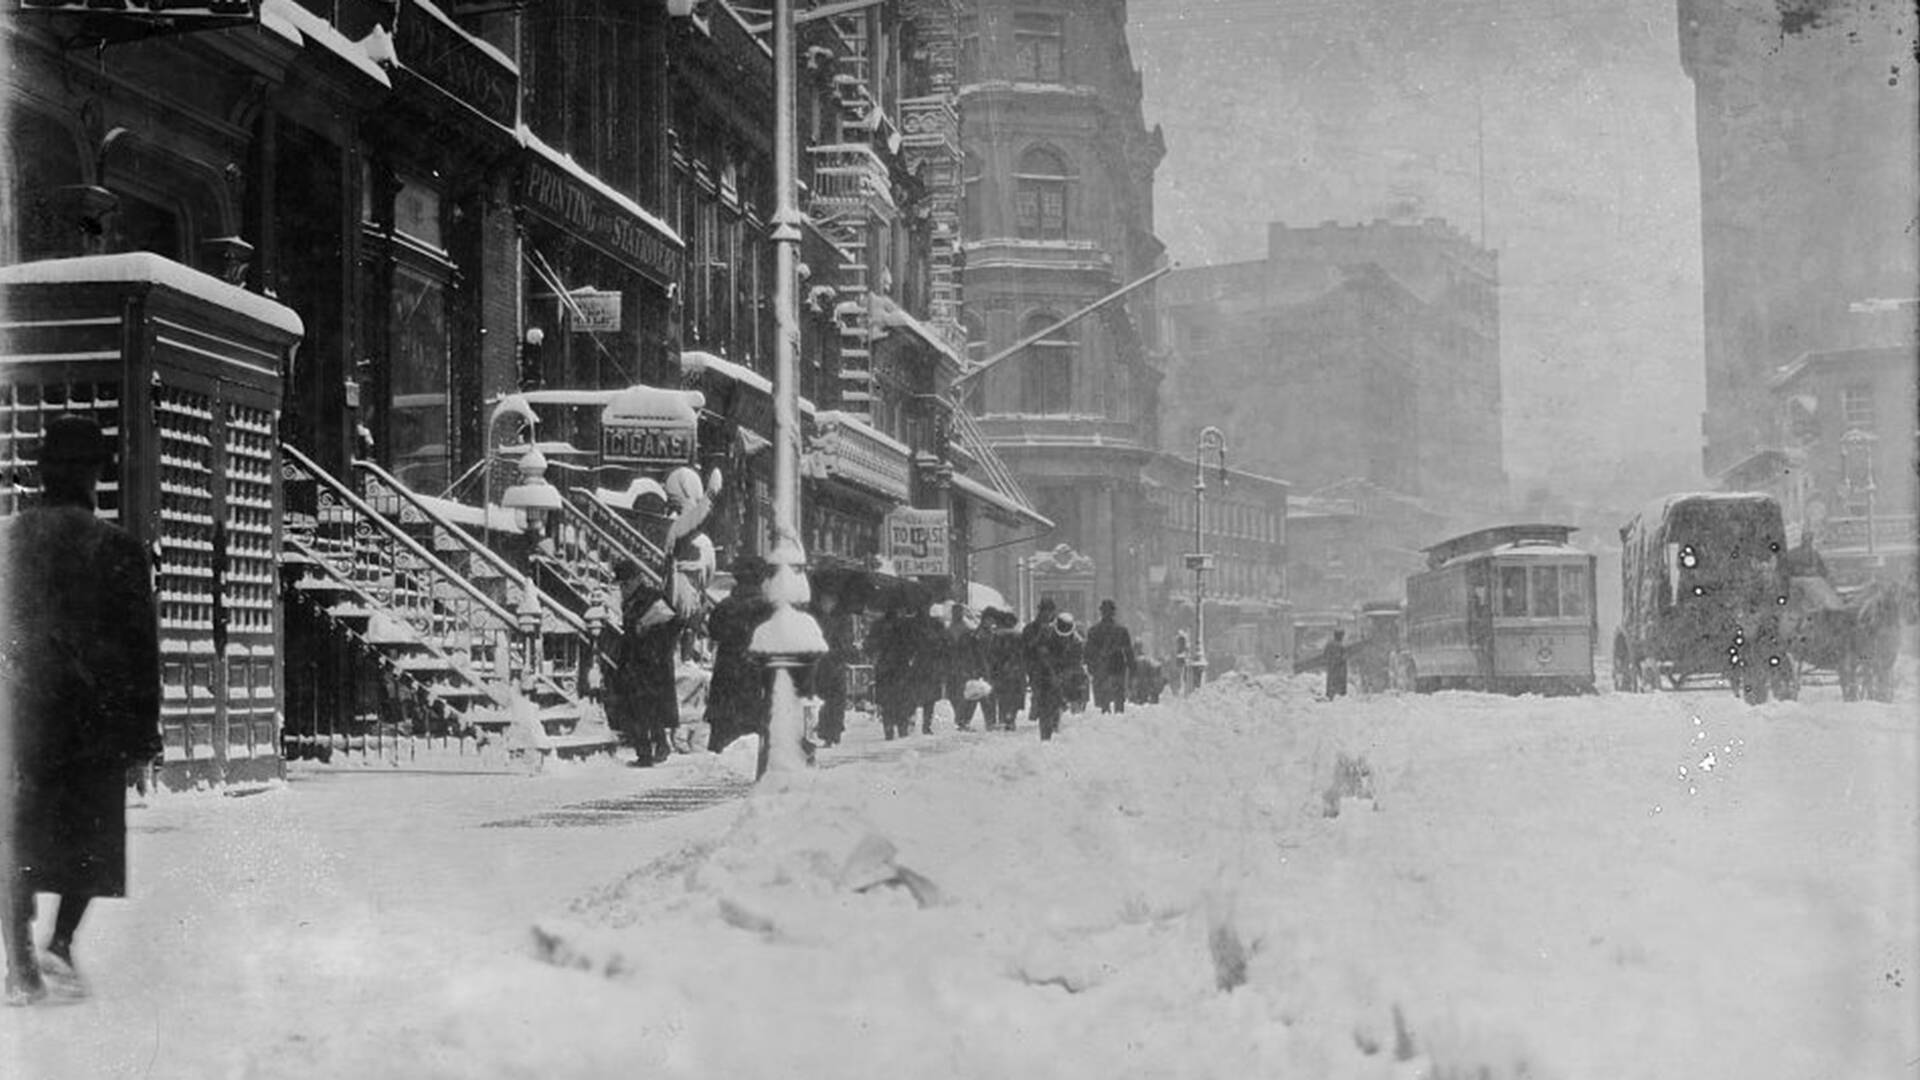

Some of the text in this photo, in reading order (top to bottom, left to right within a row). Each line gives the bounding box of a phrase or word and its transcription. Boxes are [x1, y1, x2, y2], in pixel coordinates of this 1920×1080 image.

[527, 163, 597, 231] PRINTING
[611, 433, 682, 456] CIGARS
[892, 526, 908, 543] TO
